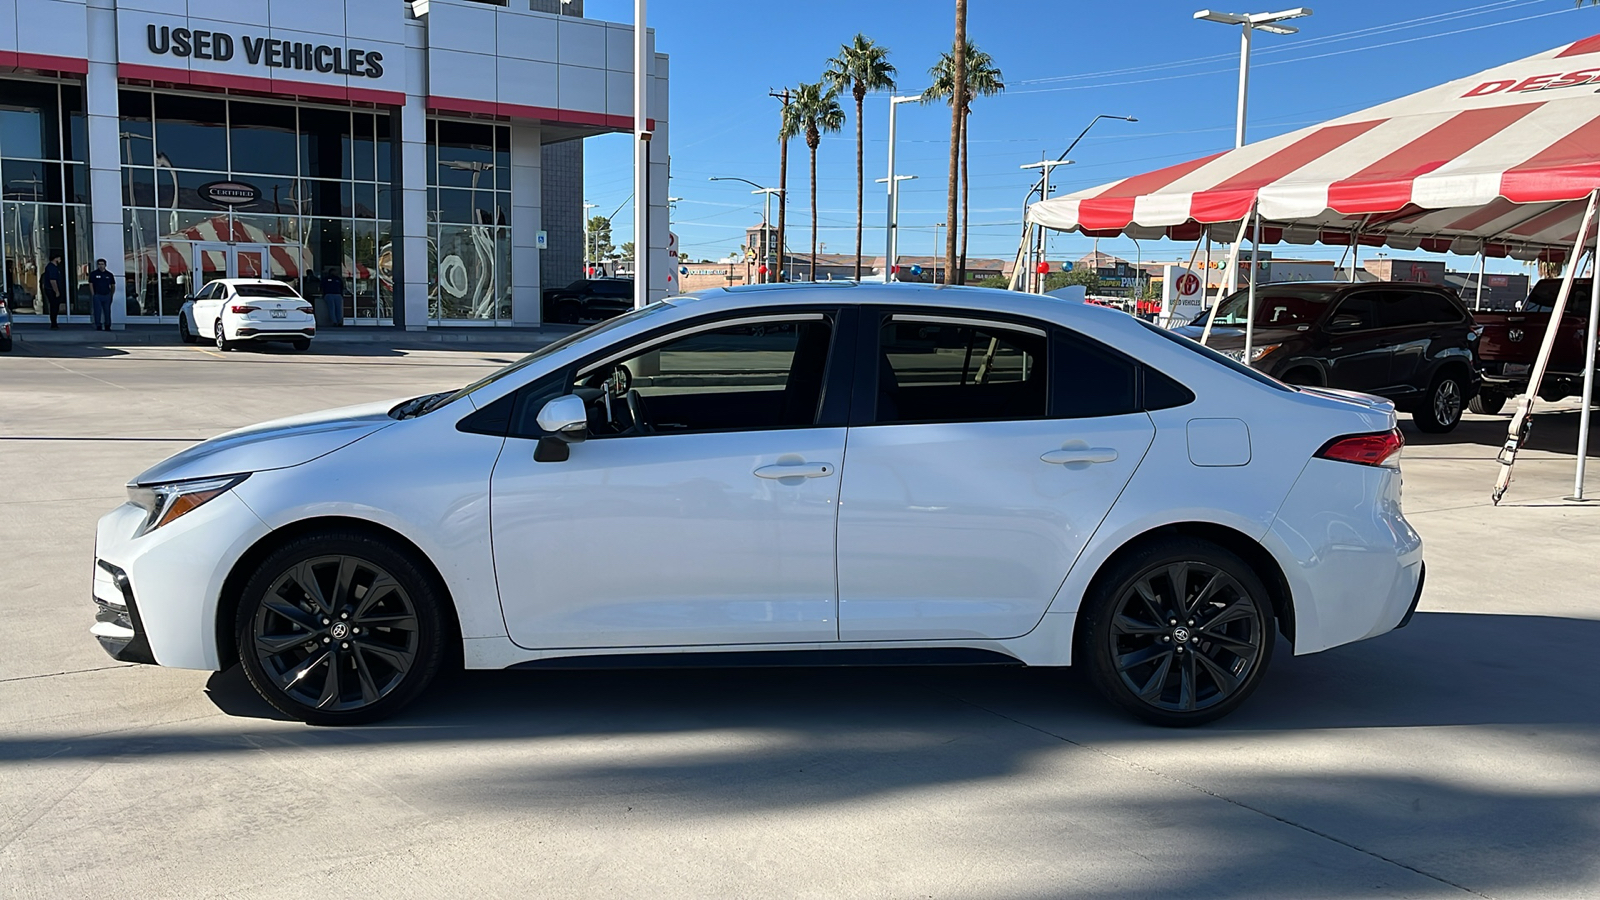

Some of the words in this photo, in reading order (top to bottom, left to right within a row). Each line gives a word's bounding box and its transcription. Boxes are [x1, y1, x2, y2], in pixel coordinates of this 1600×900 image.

[147, 24, 234, 61] USED
[242, 35, 384, 78] VEHICLES
[1459, 68, 1600, 98] DES
[209, 188, 254, 197] CERTIFIED
